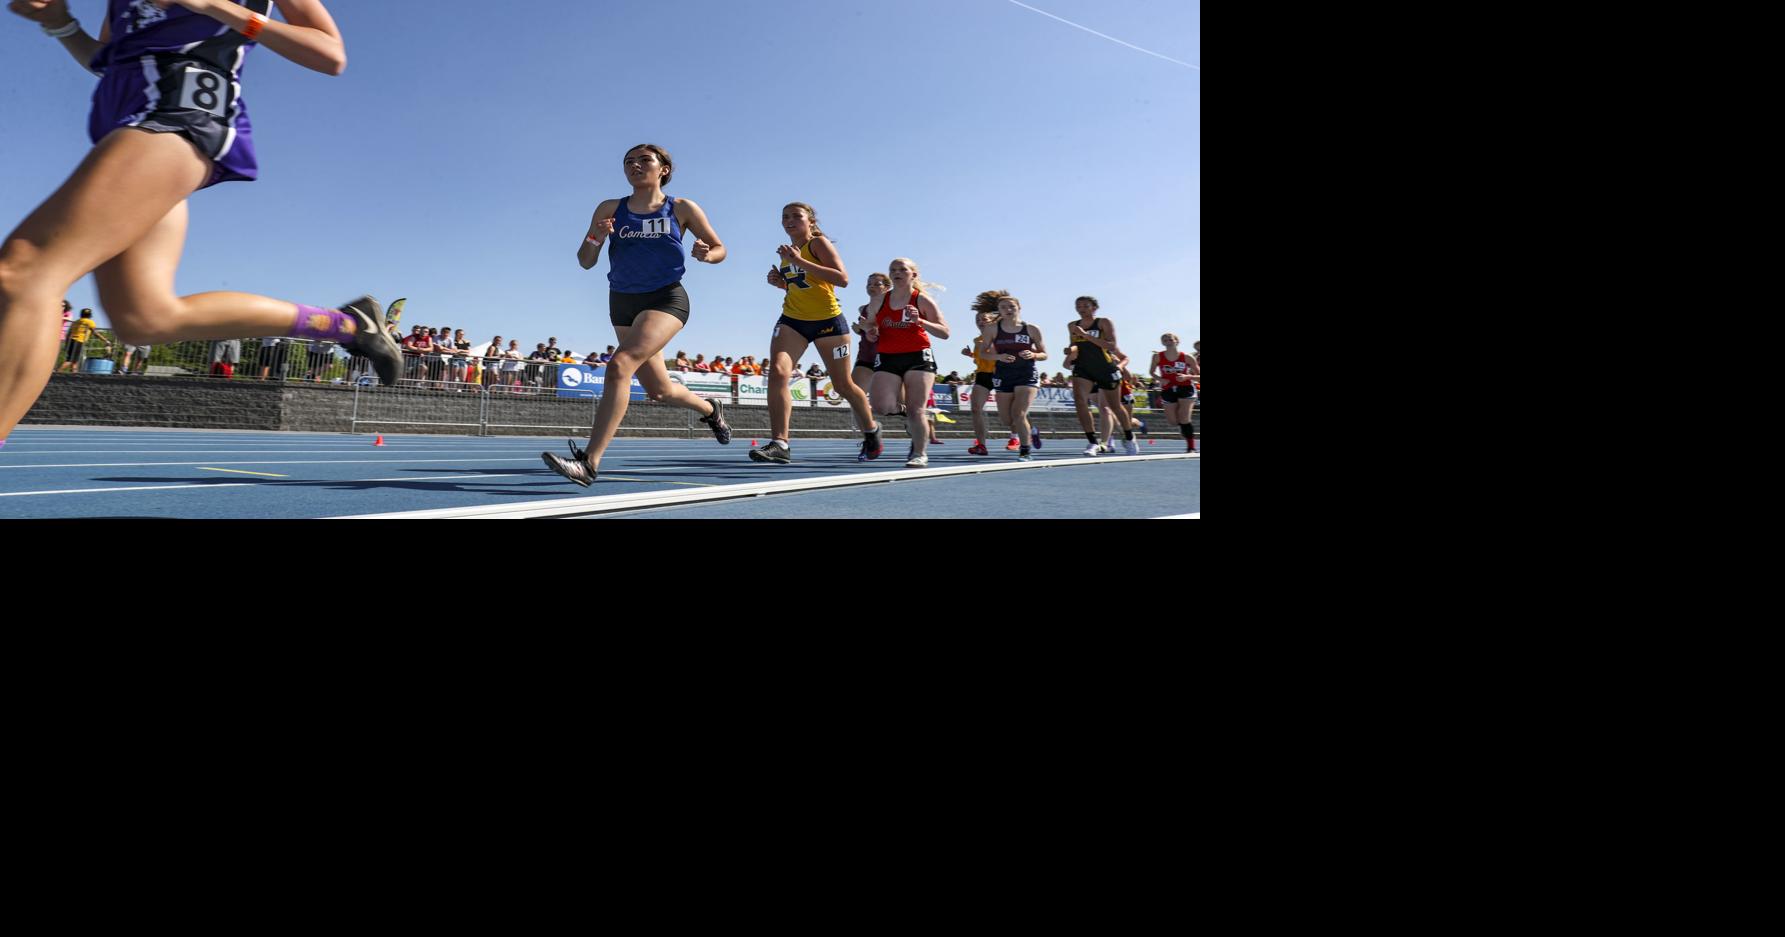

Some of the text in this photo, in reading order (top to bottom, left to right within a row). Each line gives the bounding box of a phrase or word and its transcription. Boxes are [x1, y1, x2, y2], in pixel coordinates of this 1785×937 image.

[191, 72, 219, 110] 8
[648, 218, 665, 233] 11
[1017, 335, 1028, 343] 24
[836, 345, 848, 358] 12
[583, 372, 605, 385] Ban
